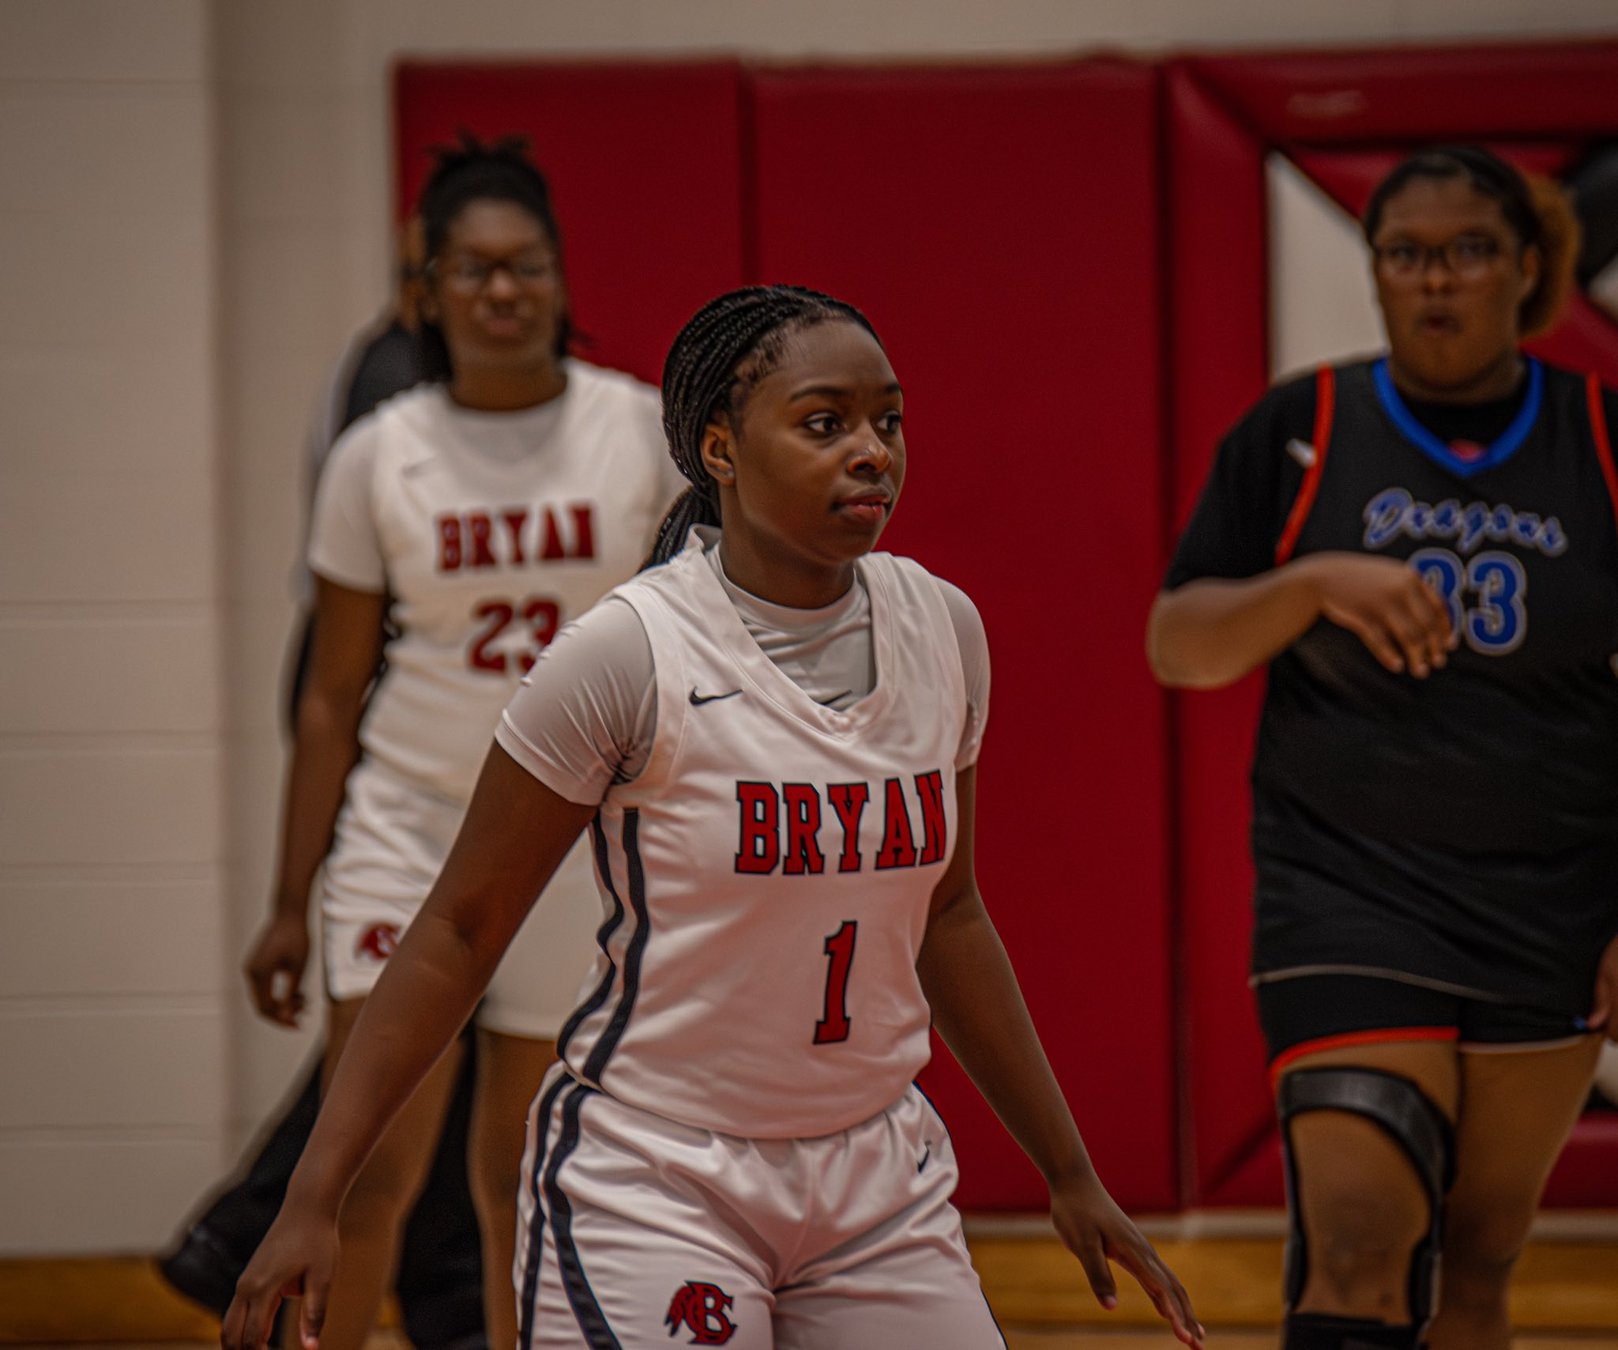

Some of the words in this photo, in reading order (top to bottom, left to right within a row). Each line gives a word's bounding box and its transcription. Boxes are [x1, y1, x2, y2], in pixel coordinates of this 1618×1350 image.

[438, 504, 597, 571] BRYAN
[467, 597, 560, 674] 23
[734, 769, 947, 875] BRYAN
[812, 920, 858, 1045] 1
